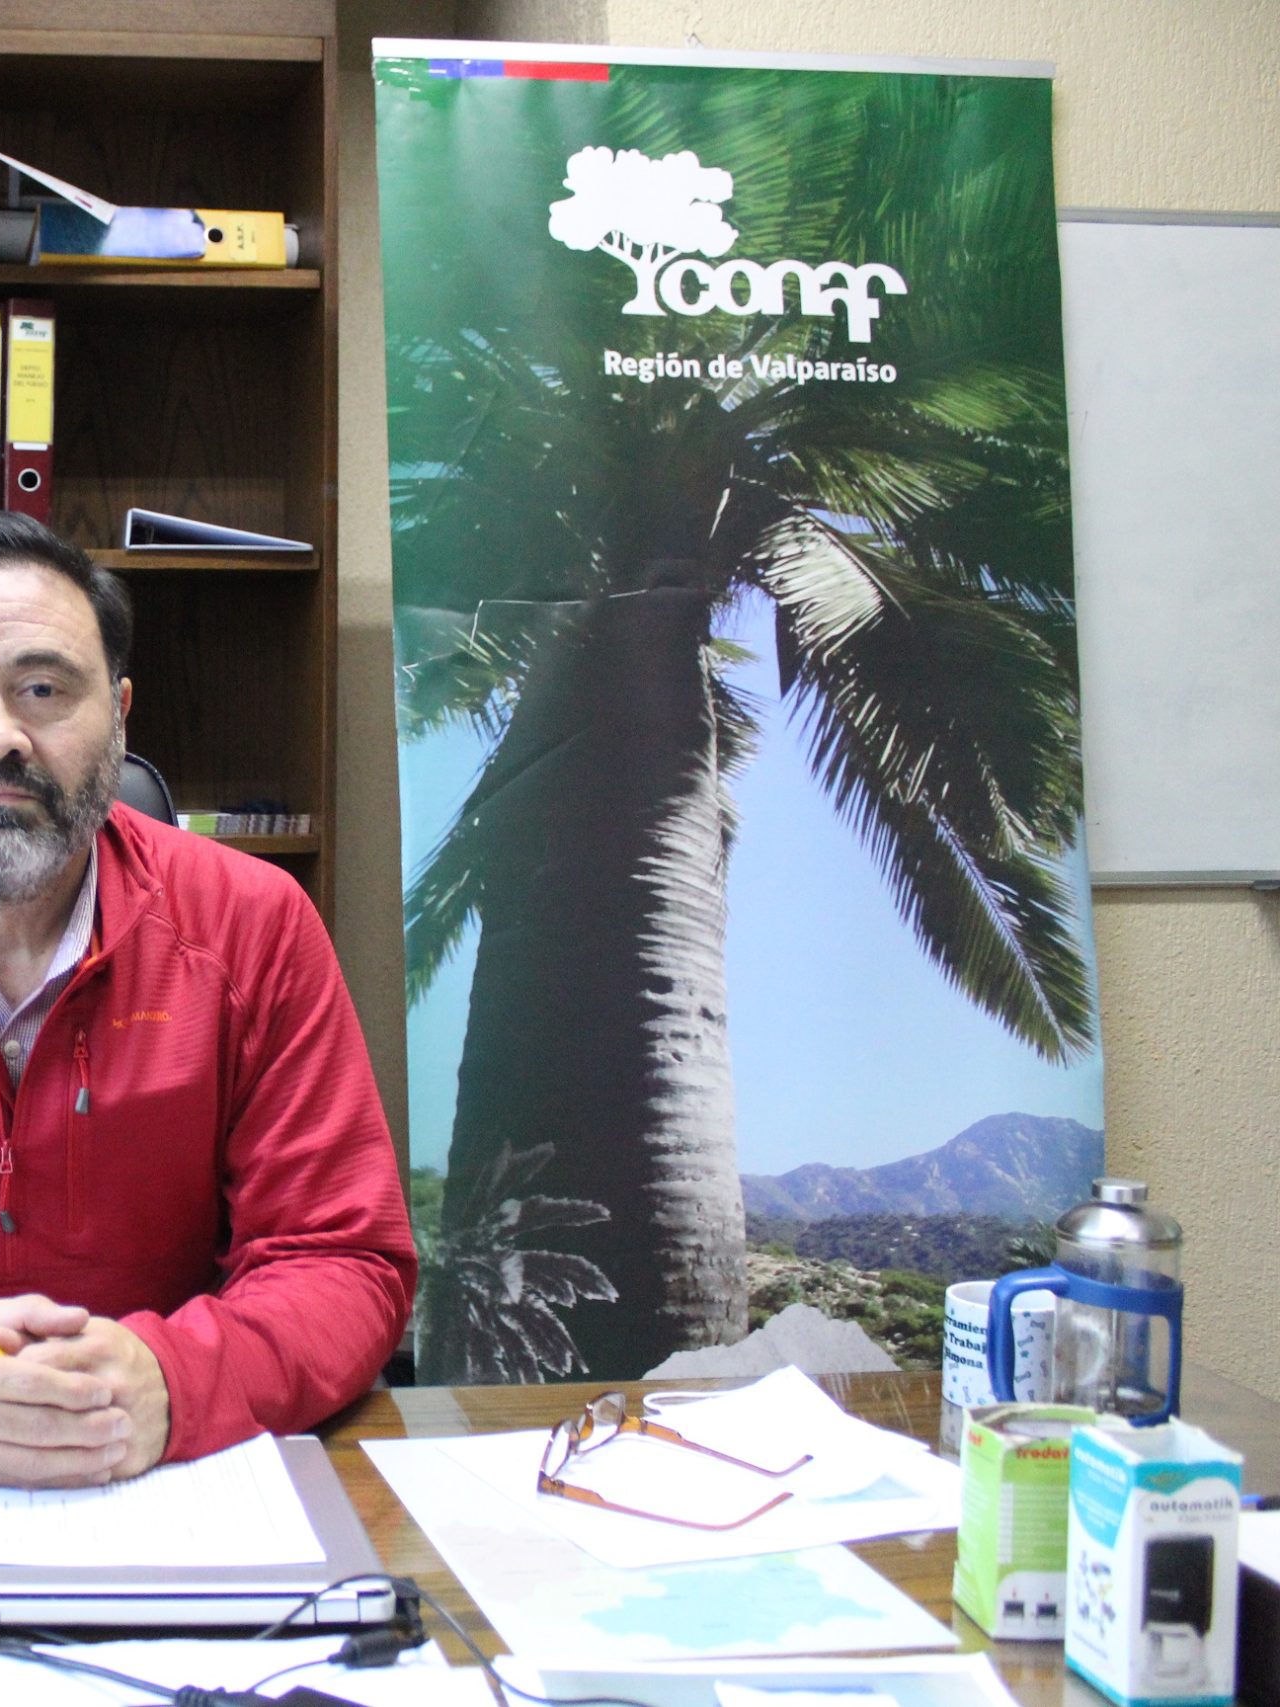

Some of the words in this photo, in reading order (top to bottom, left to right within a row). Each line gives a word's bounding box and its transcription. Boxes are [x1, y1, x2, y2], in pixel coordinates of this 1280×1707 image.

[604, 349, 701, 384] Región
[708, 354, 743, 380] de
[749, 353, 897, 385] Valparaíso
[949, 1332, 987, 1354] Trabaj
[1150, 1497, 1234, 1512] automatik
